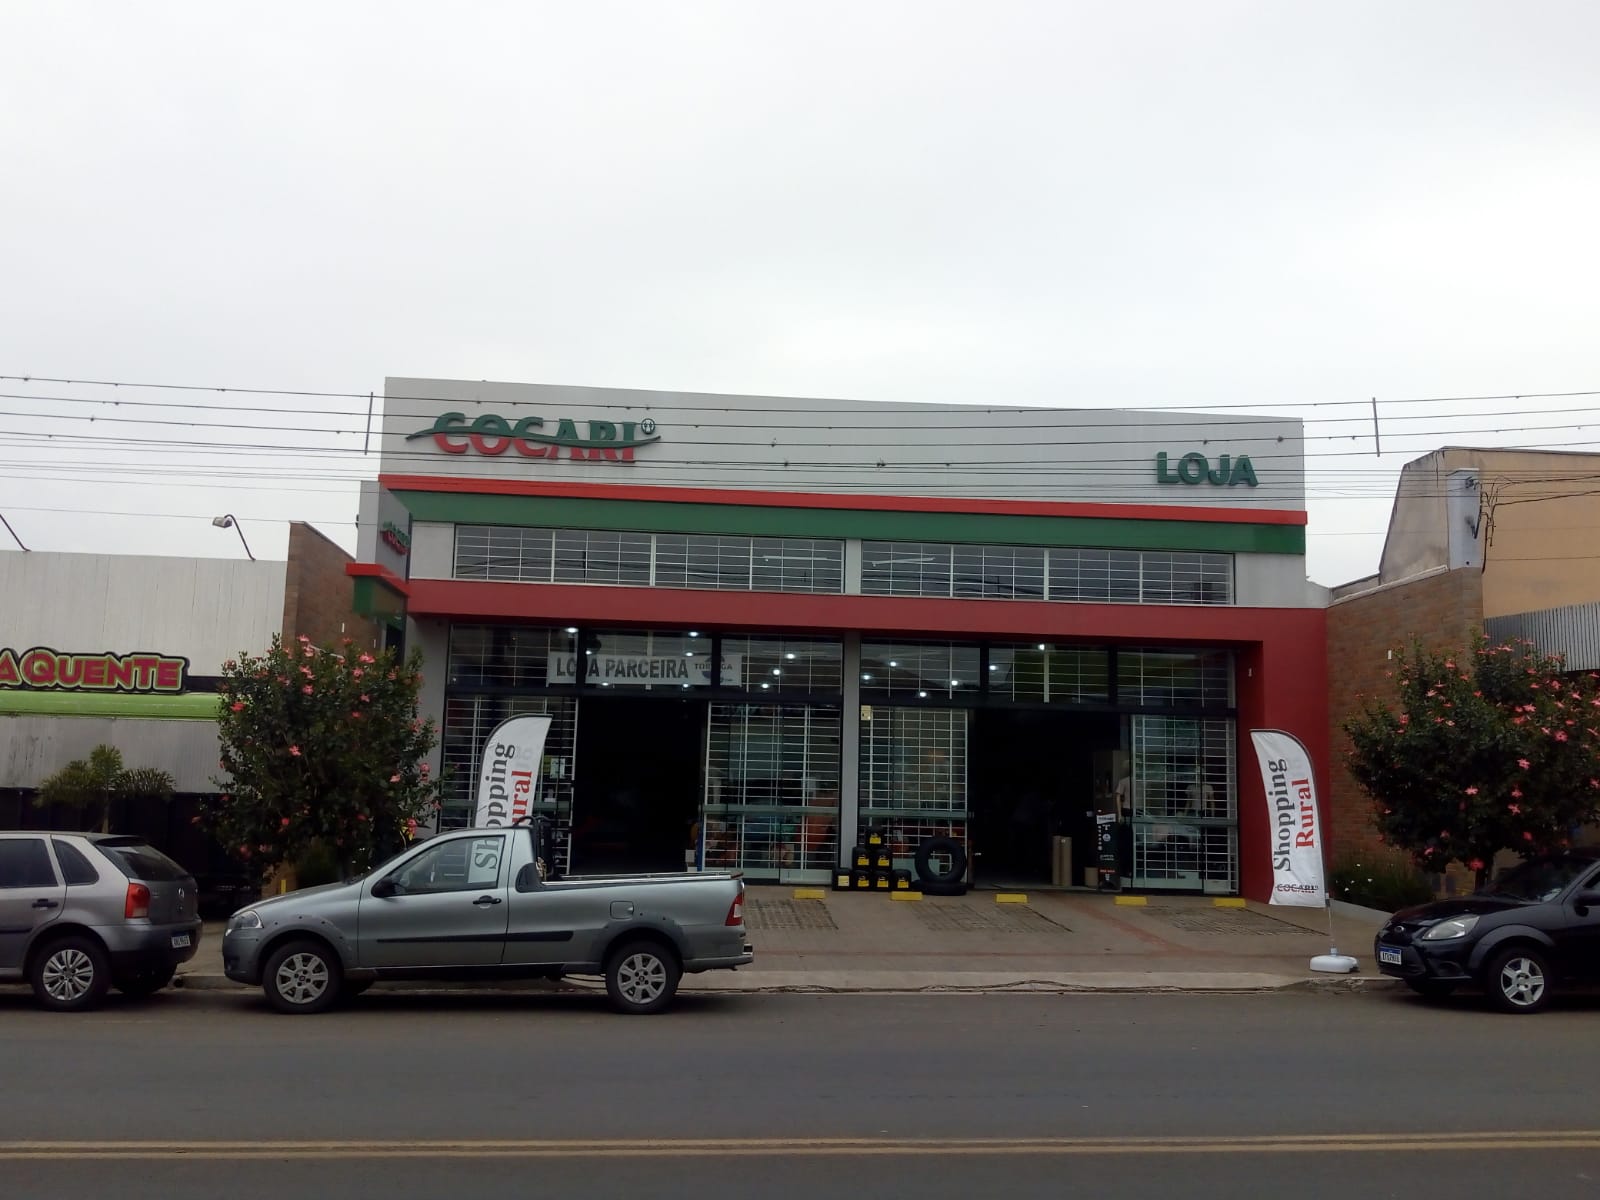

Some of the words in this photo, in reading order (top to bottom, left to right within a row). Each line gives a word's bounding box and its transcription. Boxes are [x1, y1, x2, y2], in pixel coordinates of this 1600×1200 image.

[431, 411, 637, 463] COCARI
[1156, 451, 1259, 487] LOJA
[556, 657, 600, 677] LOA
[605, 658, 689, 679] PARCEIRA
[511, 770, 532, 824] ural
[1268, 758, 1296, 872] Shopping
[1291, 777, 1315, 849] Rural
